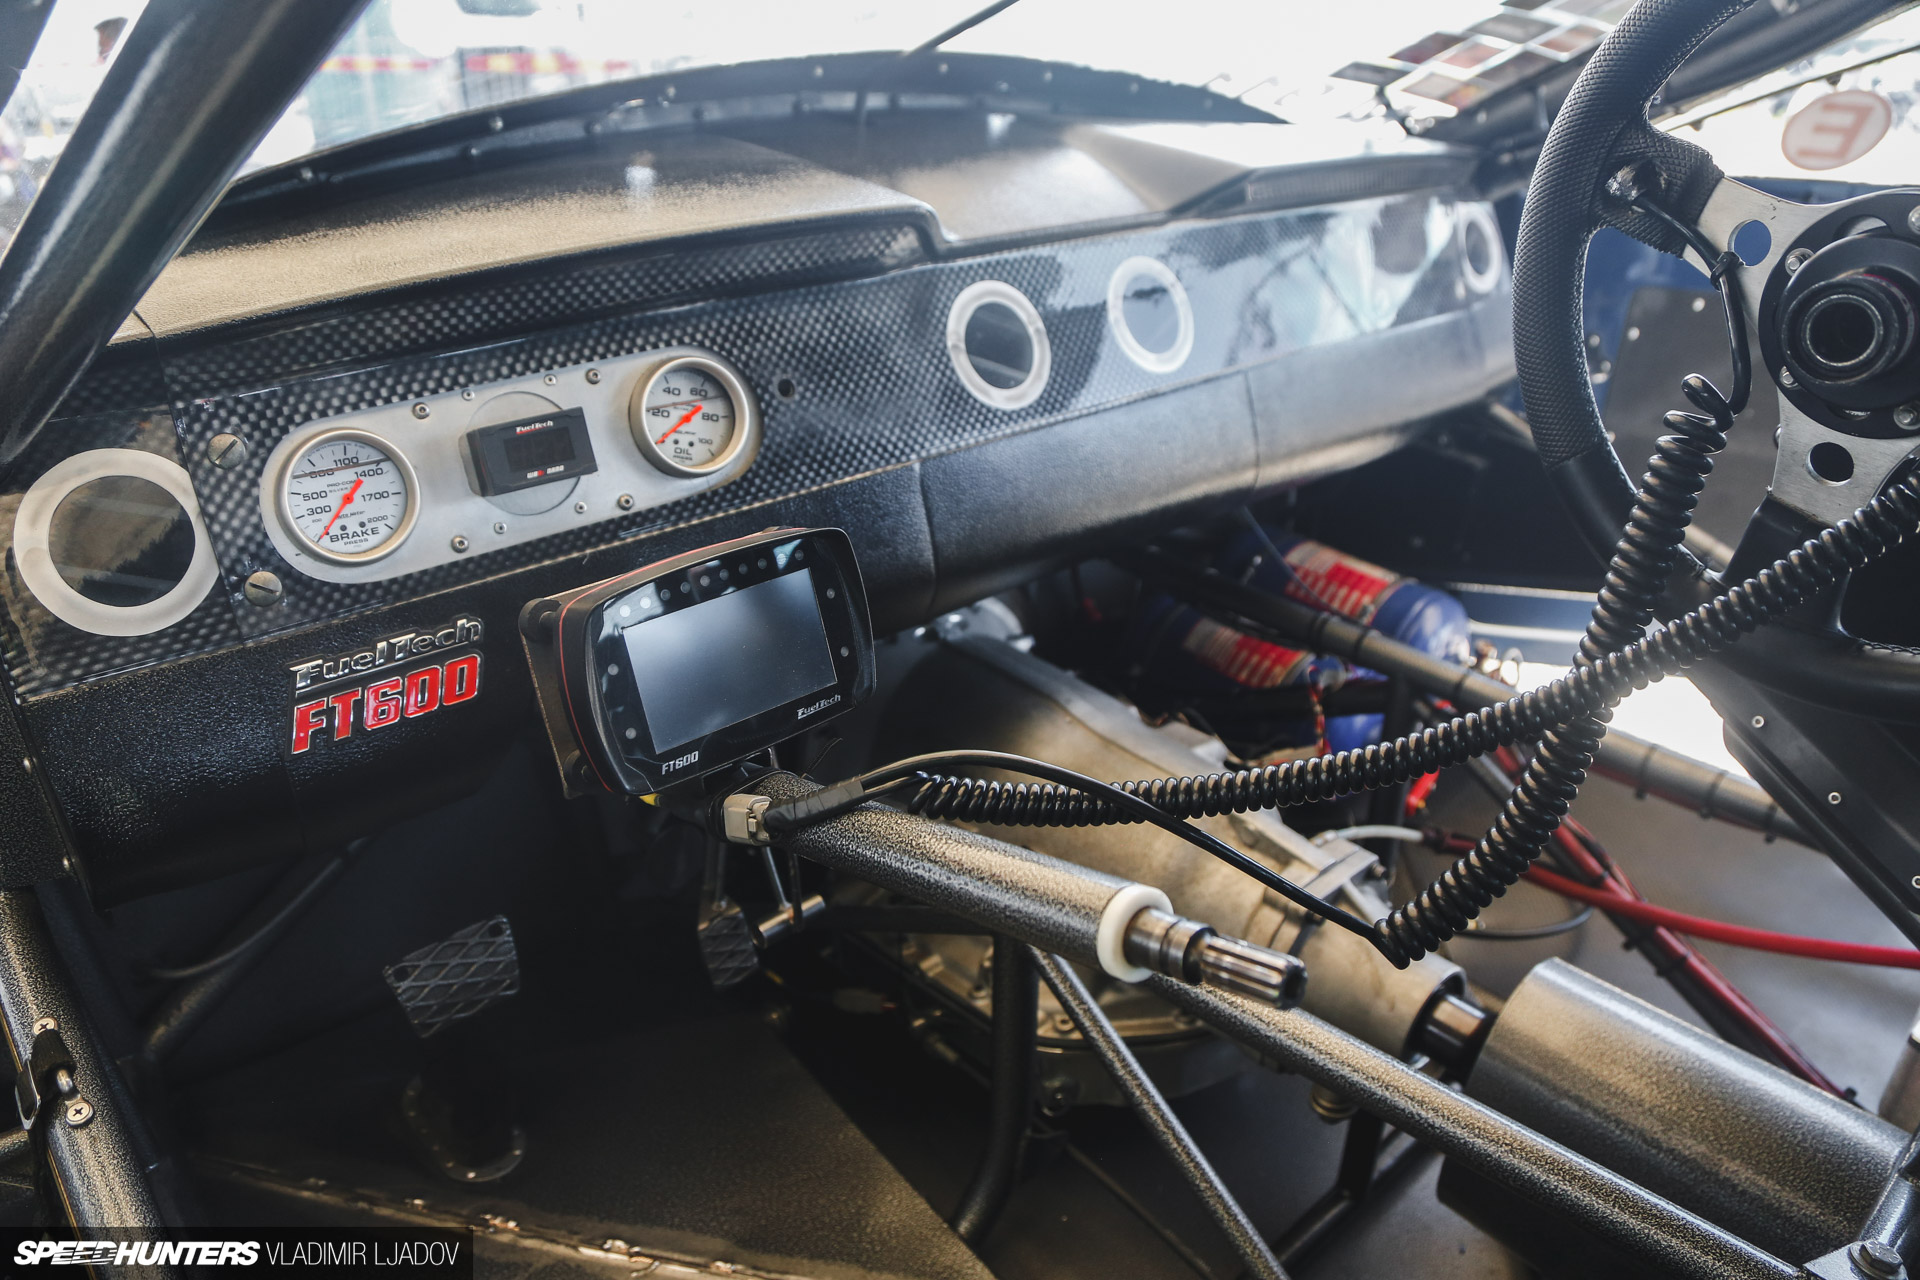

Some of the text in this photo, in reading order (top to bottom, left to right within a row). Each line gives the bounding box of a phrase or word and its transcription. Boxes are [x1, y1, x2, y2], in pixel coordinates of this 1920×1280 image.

[662, 386, 681, 396] 40
[690, 387, 708, 398] 60
[651, 408, 670, 418] 20
[702, 412, 719, 422] 80
[516, 420, 554, 433] FuelTech
[698, 437, 713, 445] 100
[674, 447, 692, 456] OIL
[333, 456, 359, 467] 1100
[354, 467, 384, 479] 1400
[302, 490, 328, 501] 500
[361, 490, 390, 502] 1700
[306, 505, 332, 516] 300
[367, 515, 389, 523] 2000
[329, 527, 380, 543] BRAKE
[344, 537, 369, 546] PRESS
[289, 618, 482, 689] FuelTech
[292, 654, 481, 755] FT600
[797, 694, 841, 718] FuelTech
[661, 750, 699, 776] FT600
